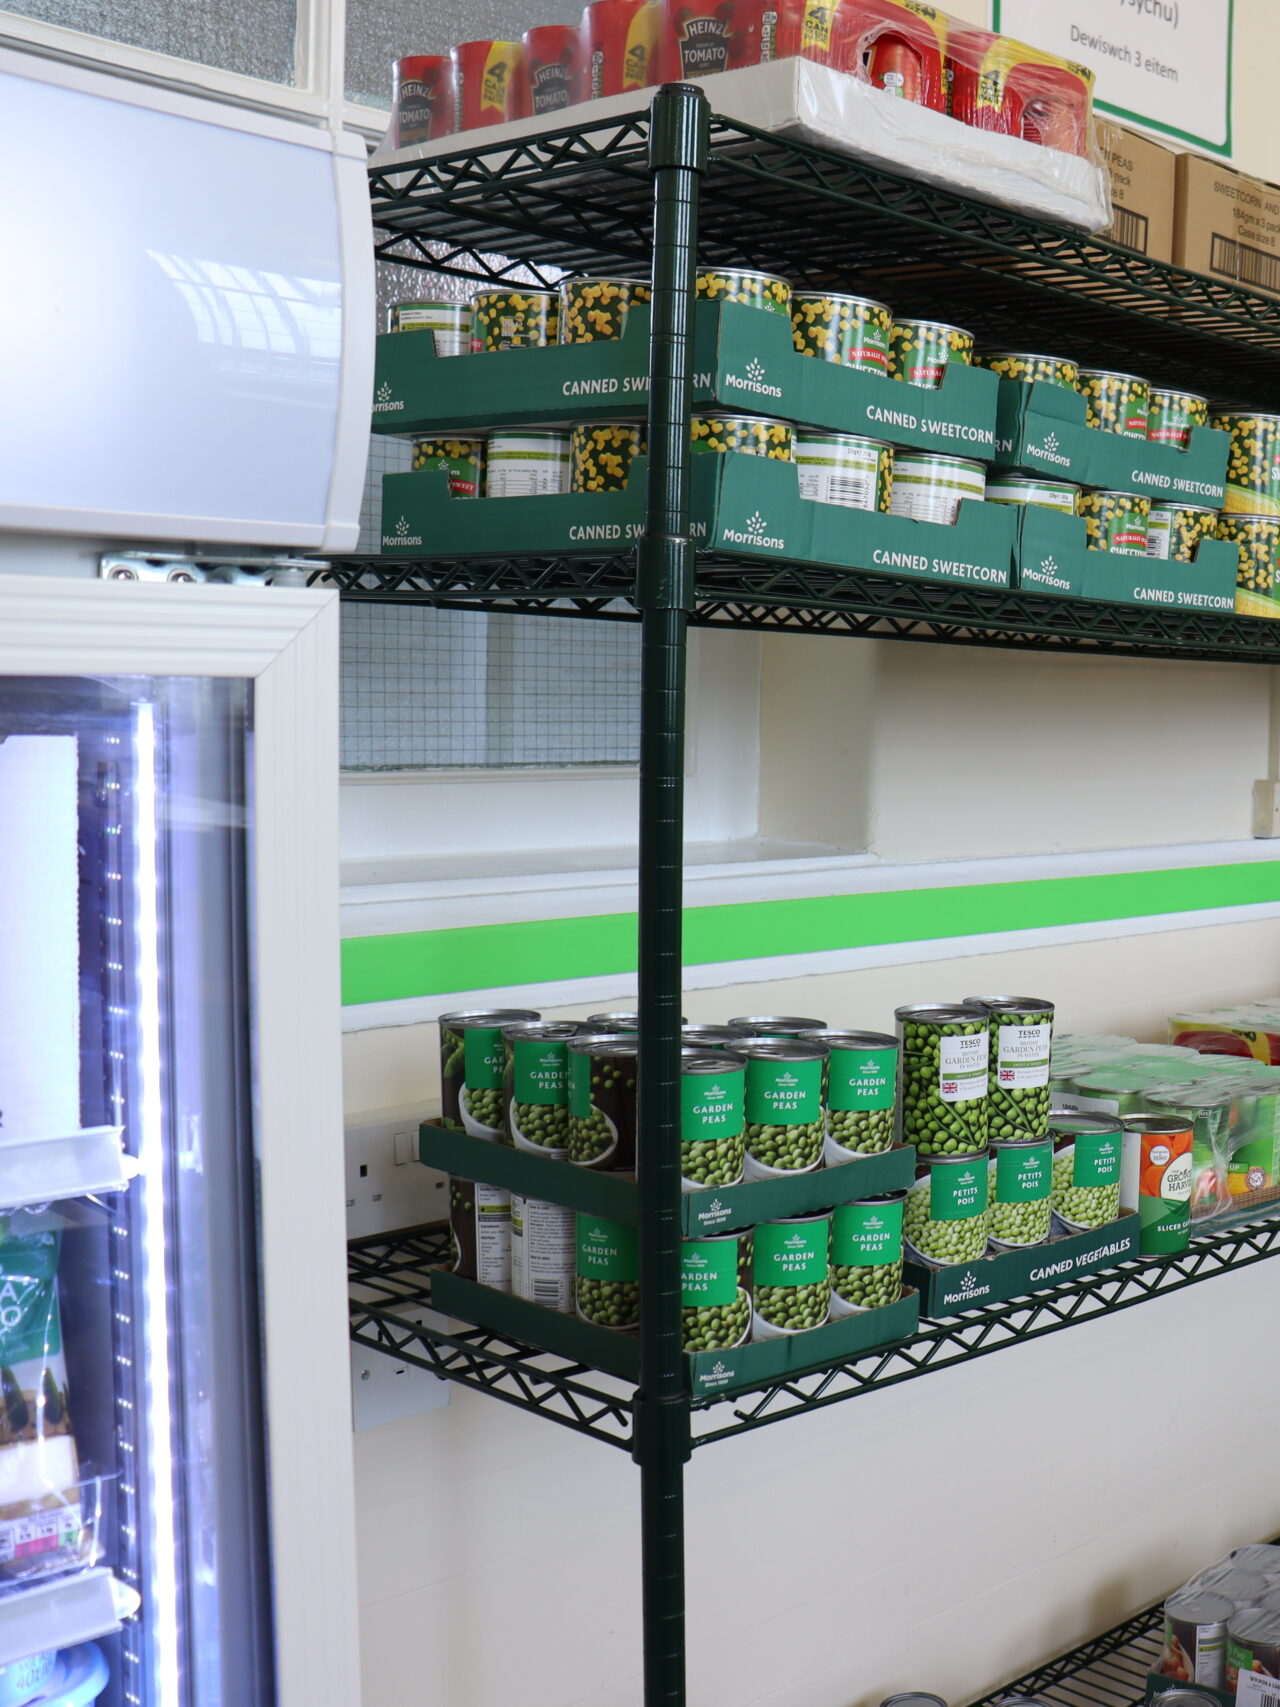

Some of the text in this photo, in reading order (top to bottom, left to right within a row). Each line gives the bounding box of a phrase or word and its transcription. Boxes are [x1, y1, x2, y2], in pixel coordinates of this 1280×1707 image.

[808, 6, 828, 23] 4
[689, 20, 724, 36] HEINZ
[806, 20, 829, 33] CAN
[684, 47, 726, 63] TOMATO
[1070, 25, 1178, 82] Dewiswch 3 eitem
[539, 65, 569, 81] HEINZ
[401, 81, 432, 98] HEINZ
[535, 90, 568, 108] TOMATO
[398, 109, 430, 124] TOMATO
[1112, 152, 1134, 172] PEAS
[1213, 181, 1262, 209] SWEETCORN
[1264, 199, 1280, 215] AND
[1237, 224, 1257, 241] Case
[1257, 231, 1269, 245] size
[563, 378, 618, 396] CANNED
[726, 373, 782, 399] Morrisons
[371, 398, 405, 413] orrisons
[867, 405, 994, 444] CANNED SWEETCORN
[1027, 443, 1071, 467] Morrisons
[1131, 470, 1224, 498] CANNED SWEETCORN
[569, 525, 621, 541] CANNED
[723, 528, 785, 549] Morrisons
[382, 534, 422, 547] Morrisons
[873, 549, 1007, 584] CANNED SWEETCORN
[1022, 568, 1070, 590] Morrisons
[1134, 587, 1234, 610] CANNED SWEETCORN
[1018, 1029, 1041, 1038] TESCO
[960, 1038, 981, 1047] TESCO
[1003, 1046, 1032, 1054] GARDEN
[484, 1057, 503, 1065] GAR
[945, 1056, 972, 1065] GARDEN
[538, 1081, 564, 1089] PEAS
[849, 1078, 886, 1087] GARDEN
[764, 1091, 806, 1100] GARDEN
[857, 1088, 879, 1096] PEAS
[693, 1103, 733, 1114] GARDEN
[773, 1102, 798, 1110] PEAS
[702, 1115, 726, 1124] PEAS
[1094, 1156, 1116, 1166] PETITS
[1098, 1165, 1113, 1174] POIS
[1018, 1171, 1042, 1181] PETITS
[1022, 1180, 1039, 1189] POIS
[1168, 1181, 1192, 1192] HARV
[953, 1187, 978, 1198] PETITS
[957, 1196, 975, 1205] POIS
[698, 1208, 732, 1221] Morrisons
[1157, 1223, 1182, 1232] SLICED
[852, 1232, 890, 1242] GARDEN
[582, 1244, 618, 1256] GARDEN
[860, 1243, 883, 1251] PEAS
[588, 1256, 609, 1266] PEAS
[773, 1251, 815, 1262] GARDEN
[1029, 1237, 1131, 1282] CANNED VEGETABLES
[782, 1262, 807, 1271] PEAS
[681, 1272, 718, 1281] ARDEN
[682, 1283, 708, 1291] PEAS
[943, 1284, 990, 1305] Morrisons
[700, 1370, 735, 1383] Morrisons
